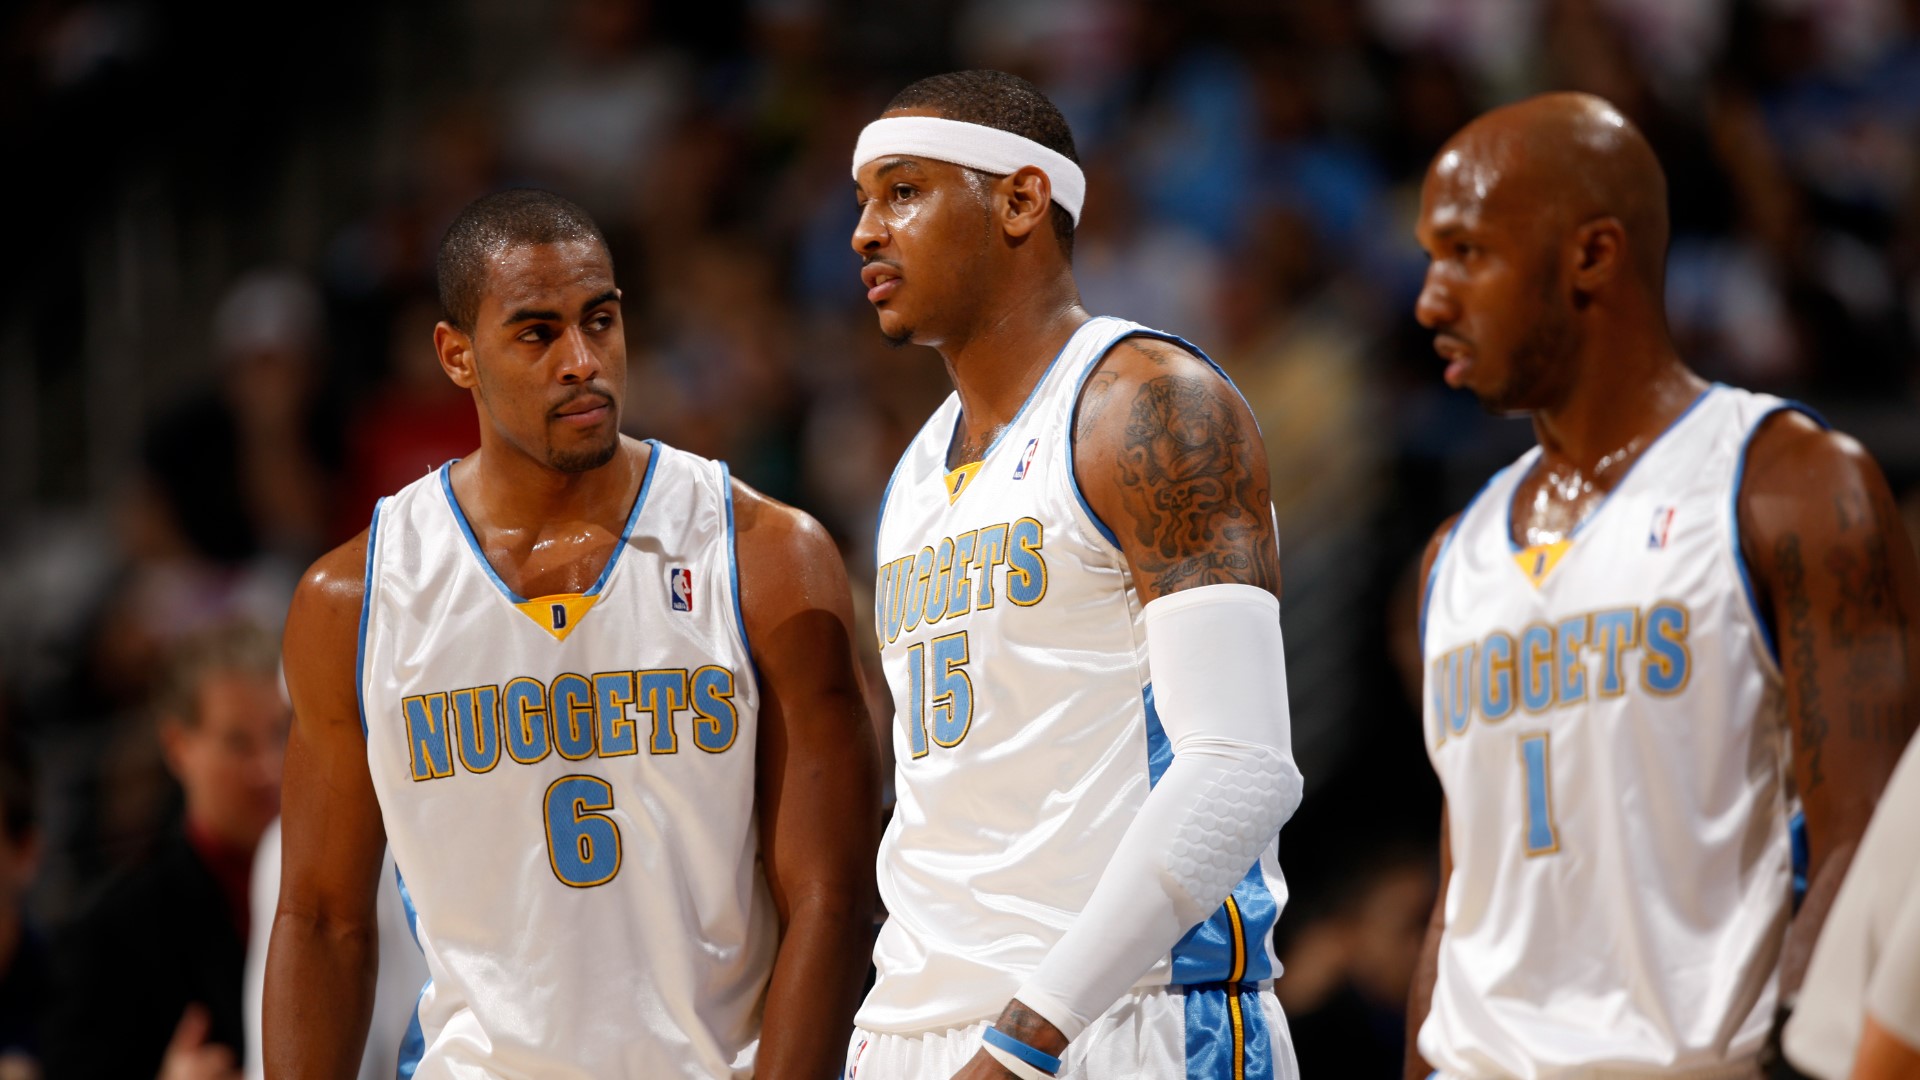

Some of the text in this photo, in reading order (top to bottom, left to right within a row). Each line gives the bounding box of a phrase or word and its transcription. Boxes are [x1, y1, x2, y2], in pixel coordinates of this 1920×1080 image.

[551, 603, 567, 630] D
[402, 664, 739, 782] NUGGETS
[907, 630, 973, 760] 15
[543, 774, 622, 888] 6
[1517, 731, 1560, 859] 1
